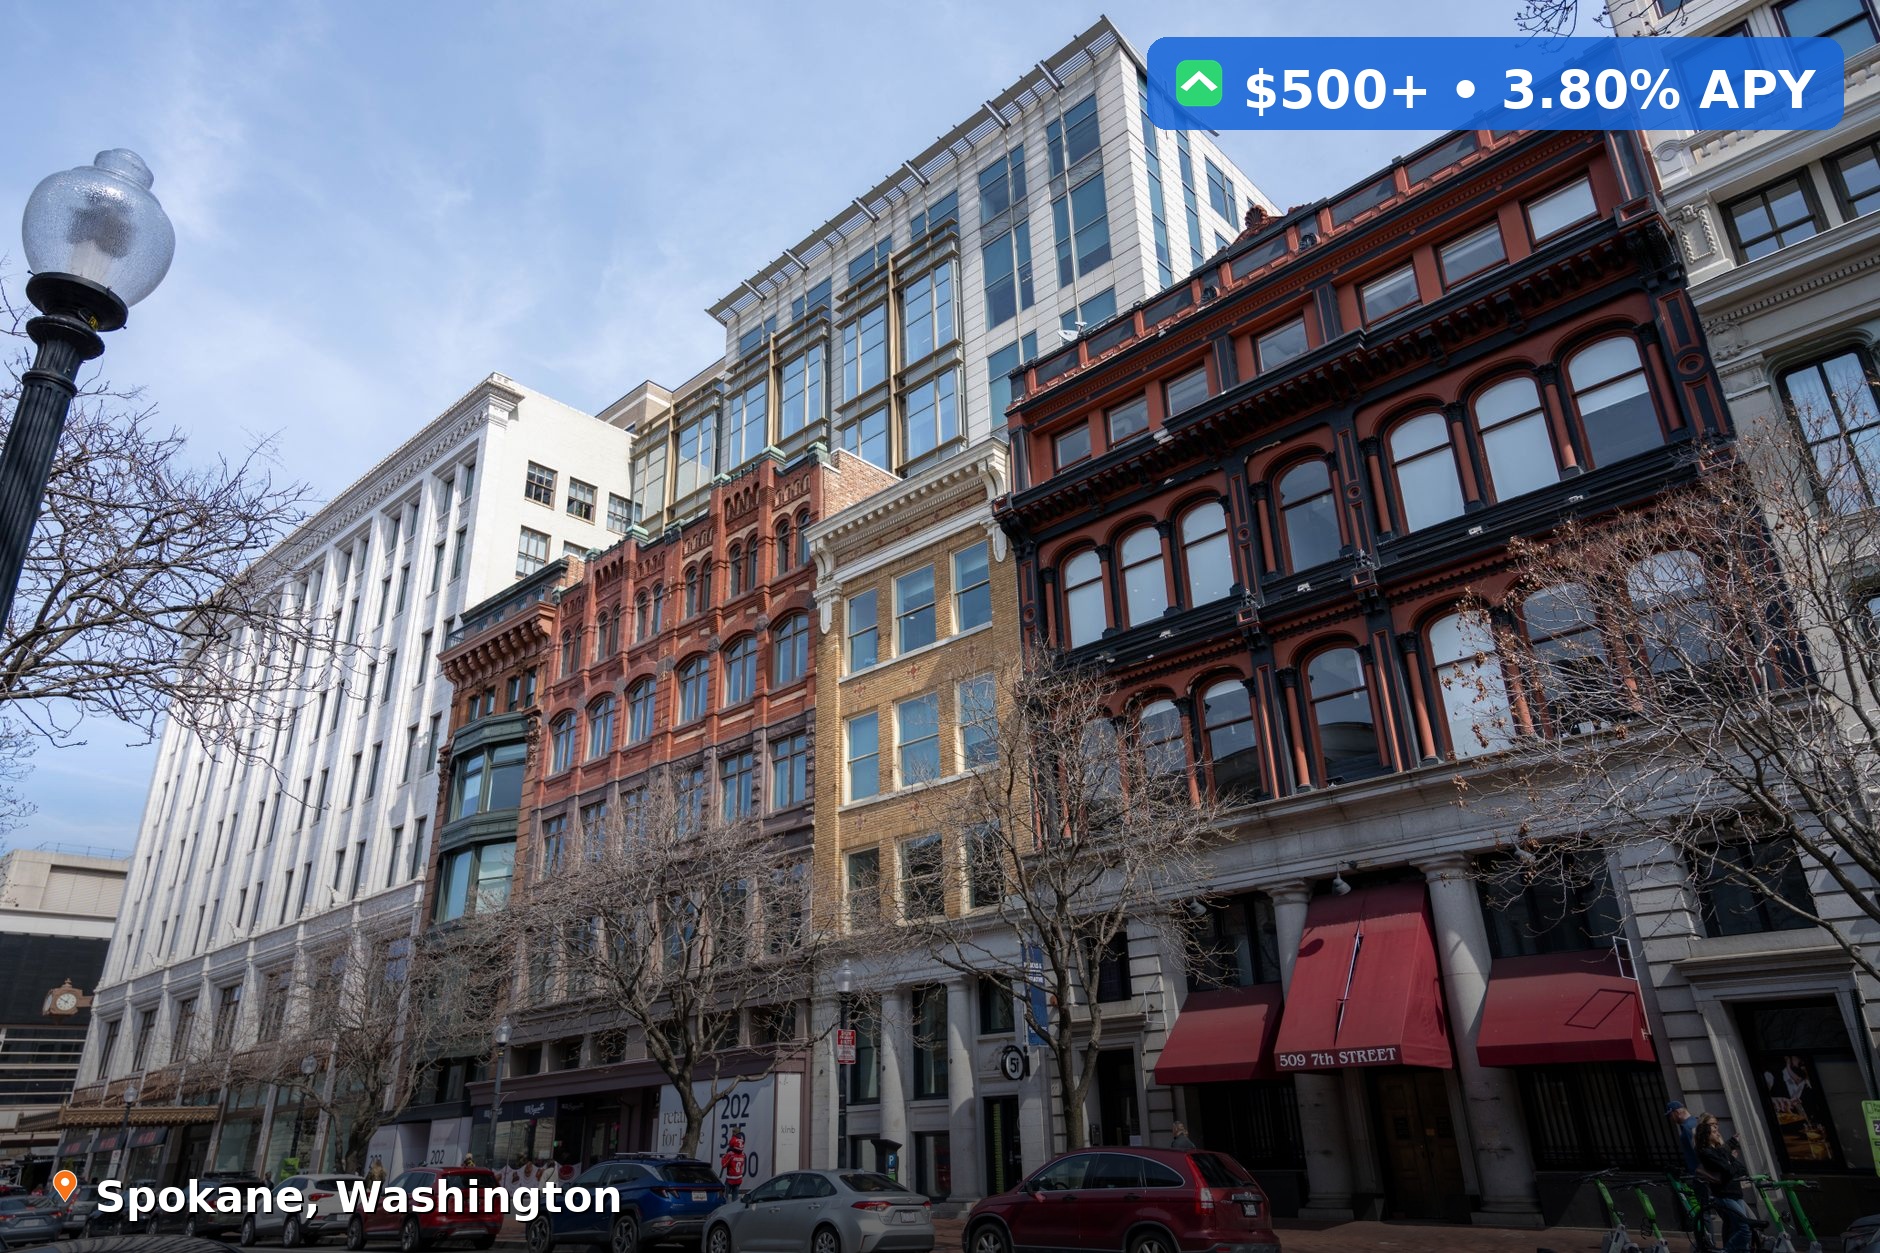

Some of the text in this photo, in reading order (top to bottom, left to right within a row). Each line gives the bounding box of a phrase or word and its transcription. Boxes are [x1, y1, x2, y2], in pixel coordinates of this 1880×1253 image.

[1279, 1047, 1397, 1068] 509 7th STREET
[721, 1093, 751, 1120] 202
[662, 1128, 678, 1148] for
[430, 1149, 445, 1165] 202
